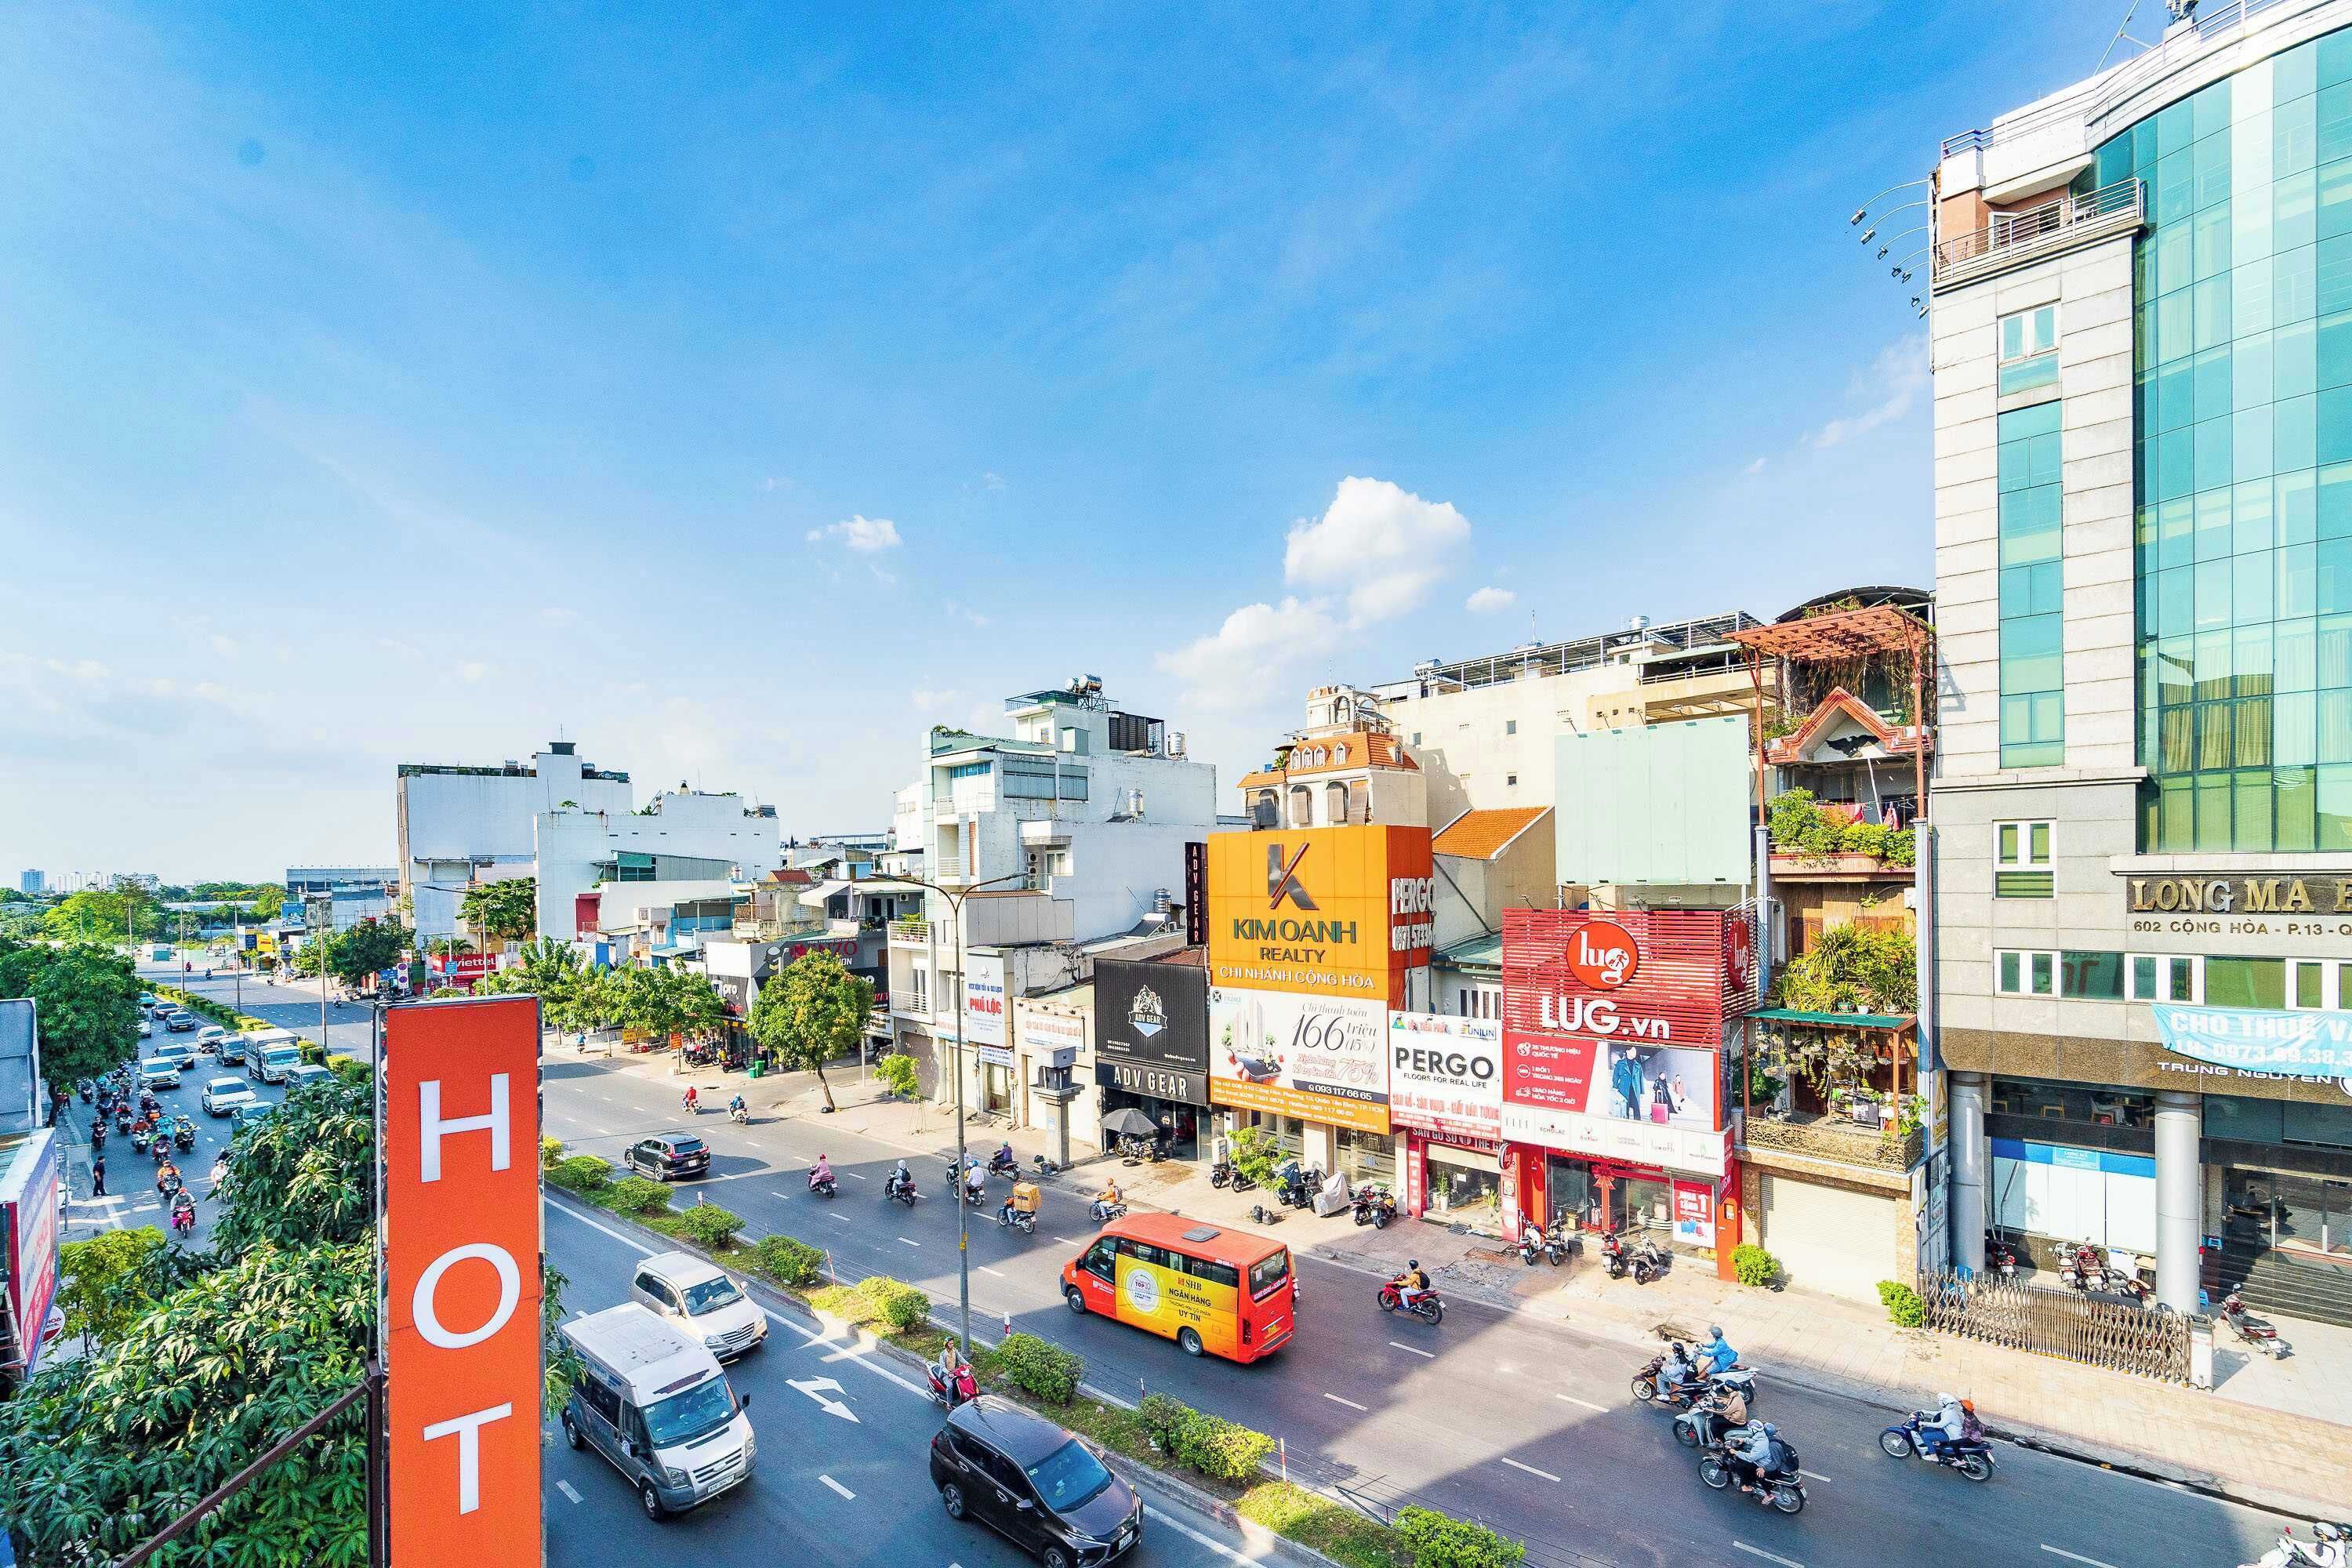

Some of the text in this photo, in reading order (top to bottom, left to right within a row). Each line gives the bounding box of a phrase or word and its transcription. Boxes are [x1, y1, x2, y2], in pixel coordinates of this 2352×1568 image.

[1392, 877, 1436, 915] PERGO
[2132, 880, 2234, 912] LONG
[2245, 879, 2315, 913] MA
[1233, 919, 1356, 943] KIM OANH
[2133, 920, 2161, 932] 602
[2170, 919, 2221, 935] CỘNG
[2230, 918, 2268, 935] HÒA
[2288, 923, 2322, 935] P.13
[1260, 946, 1326, 964] REALTY
[1578, 931, 1630, 984] lug
[1219, 966, 1375, 989] CHI NHÁNH CỘNG HÒA
[970, 996, 1002, 1016] PHÚ LỘC
[1541, 995, 1670, 1040] LUG.vn
[1134, 1013, 1161, 1025] ADV GEAR
[2170, 1011, 2229, 1035] CHO
[1292, 1014, 1345, 1051] 166
[1347, 1022, 1377, 1039] triệu
[1396, 1047, 1494, 1080] PERGO
[2157, 1062, 2229, 1076] TRUNG
[1114, 1066, 1188, 1098] ADV GEAR
[1403, 1073, 1431, 1081] FLOORS
[1450, 1078, 1469, 1087] REAL
[1316, 1084, 1372, 1101] 093 117 66 65
[412, 1073, 521, 1515] HOT
[1185, 1279, 1202, 1291] SHB
[1169, 1287, 1211, 1307] NGÂN HÀNG
[1178, 1308, 1189, 1318] UY
